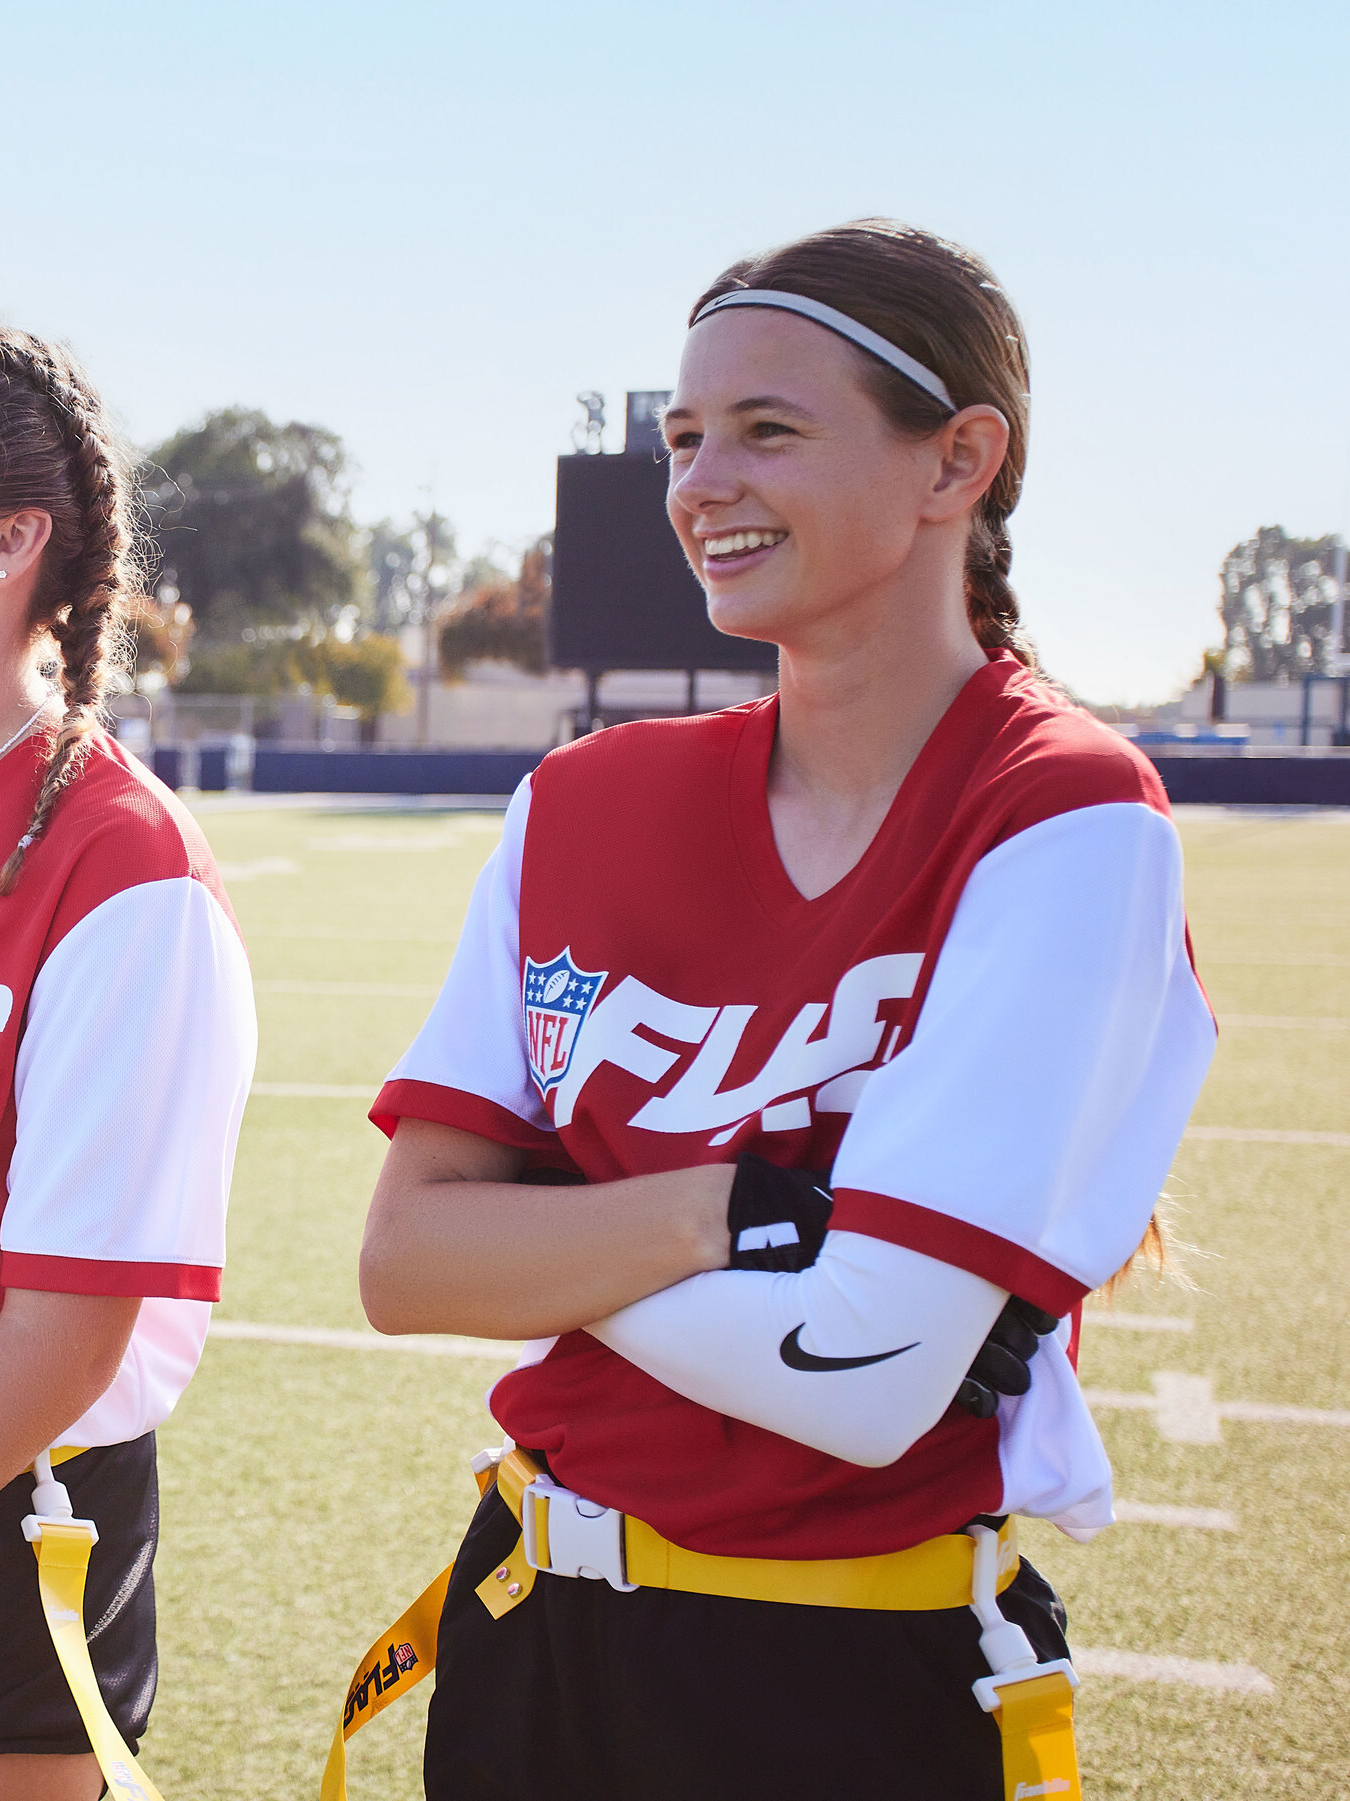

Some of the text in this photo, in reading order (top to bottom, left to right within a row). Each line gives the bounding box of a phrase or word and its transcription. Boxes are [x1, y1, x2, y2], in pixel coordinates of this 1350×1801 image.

[528, 1010, 569, 1077] NFL
[343, 1643, 414, 1730] NFL FLAG
